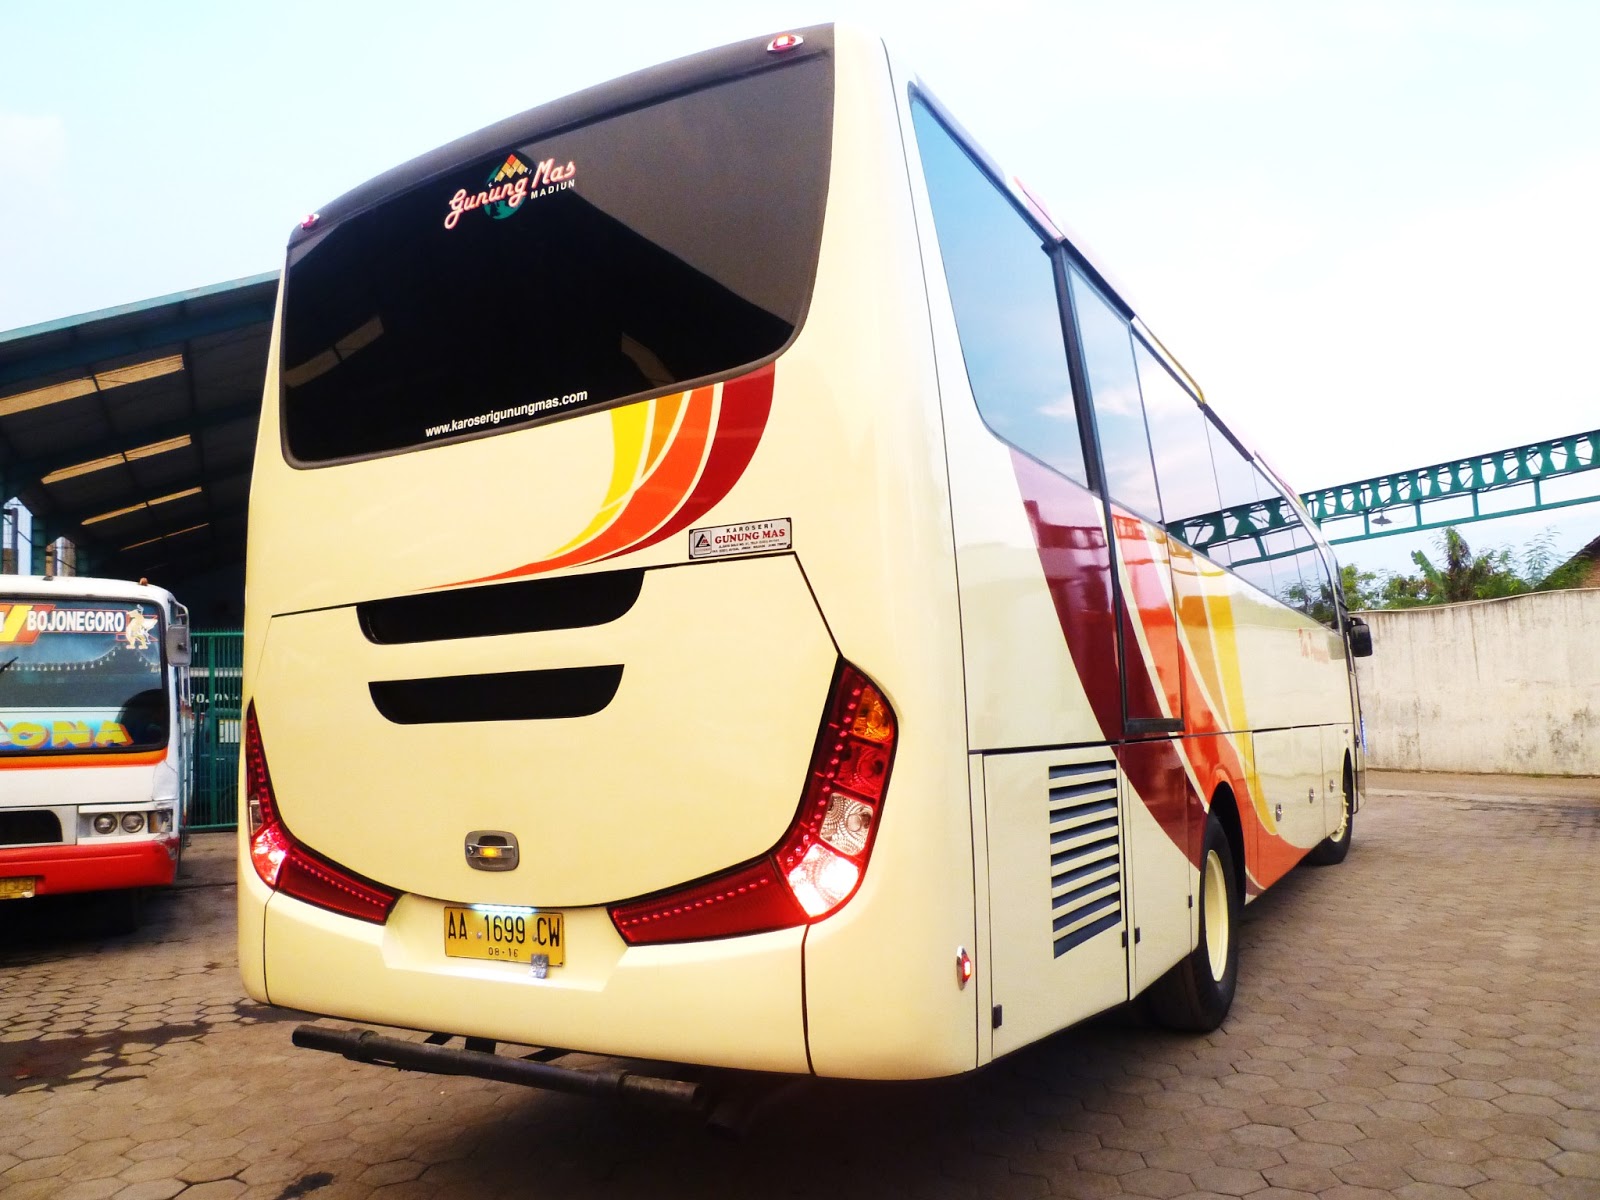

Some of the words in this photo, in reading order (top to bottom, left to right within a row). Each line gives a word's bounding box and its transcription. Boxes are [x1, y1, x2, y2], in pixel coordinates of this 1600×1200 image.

[444, 176, 529, 230] Gunung
[531, 157, 577, 189] Mas
[530, 179, 576, 200] MADIUN
[425, 390, 588, 437] www.karoserigunungmas.com
[714, 532, 760, 545] GUNUNG
[762, 528, 786, 539] MAS
[726, 523, 774, 533] KAROSERI
[27, 610, 125, 632] BOJONEGORO
[448, 911, 468, 940] AA
[484, 914, 526, 944] 1699
[536, 917, 561, 947] CW
